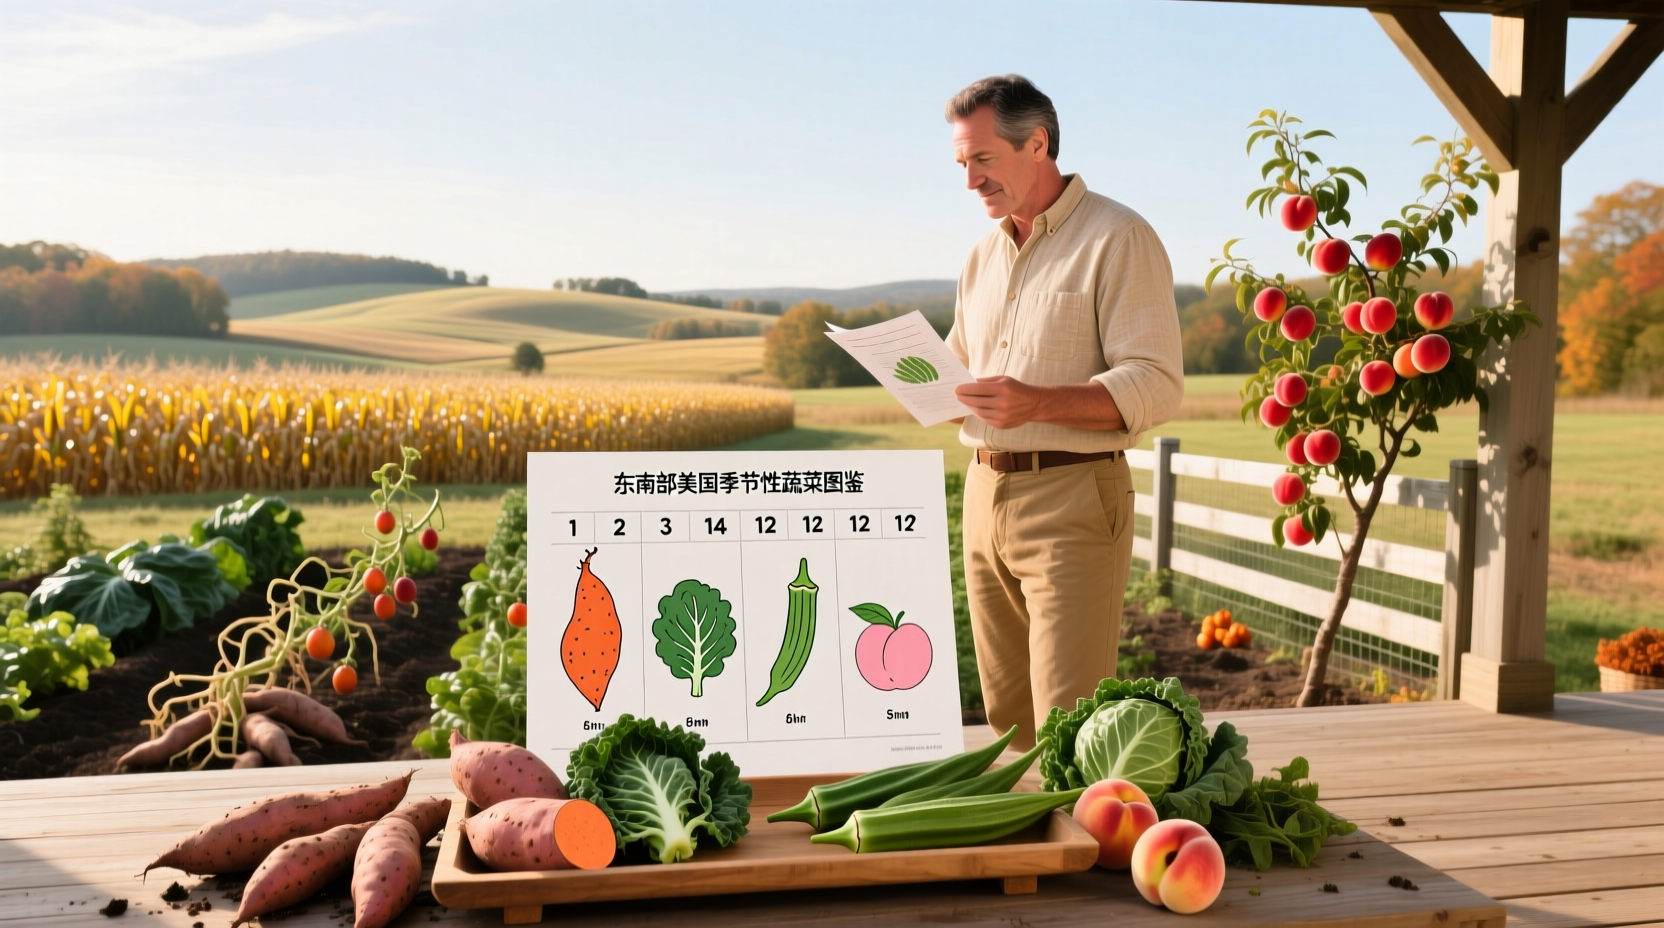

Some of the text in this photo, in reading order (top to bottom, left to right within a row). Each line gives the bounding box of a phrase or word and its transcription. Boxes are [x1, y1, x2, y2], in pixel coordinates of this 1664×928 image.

[614, 470, 865, 496] 东南部美国季节性蔬菜图鉴
[568, 514, 917, 537] 1 2 3 14 12 12 12 12
